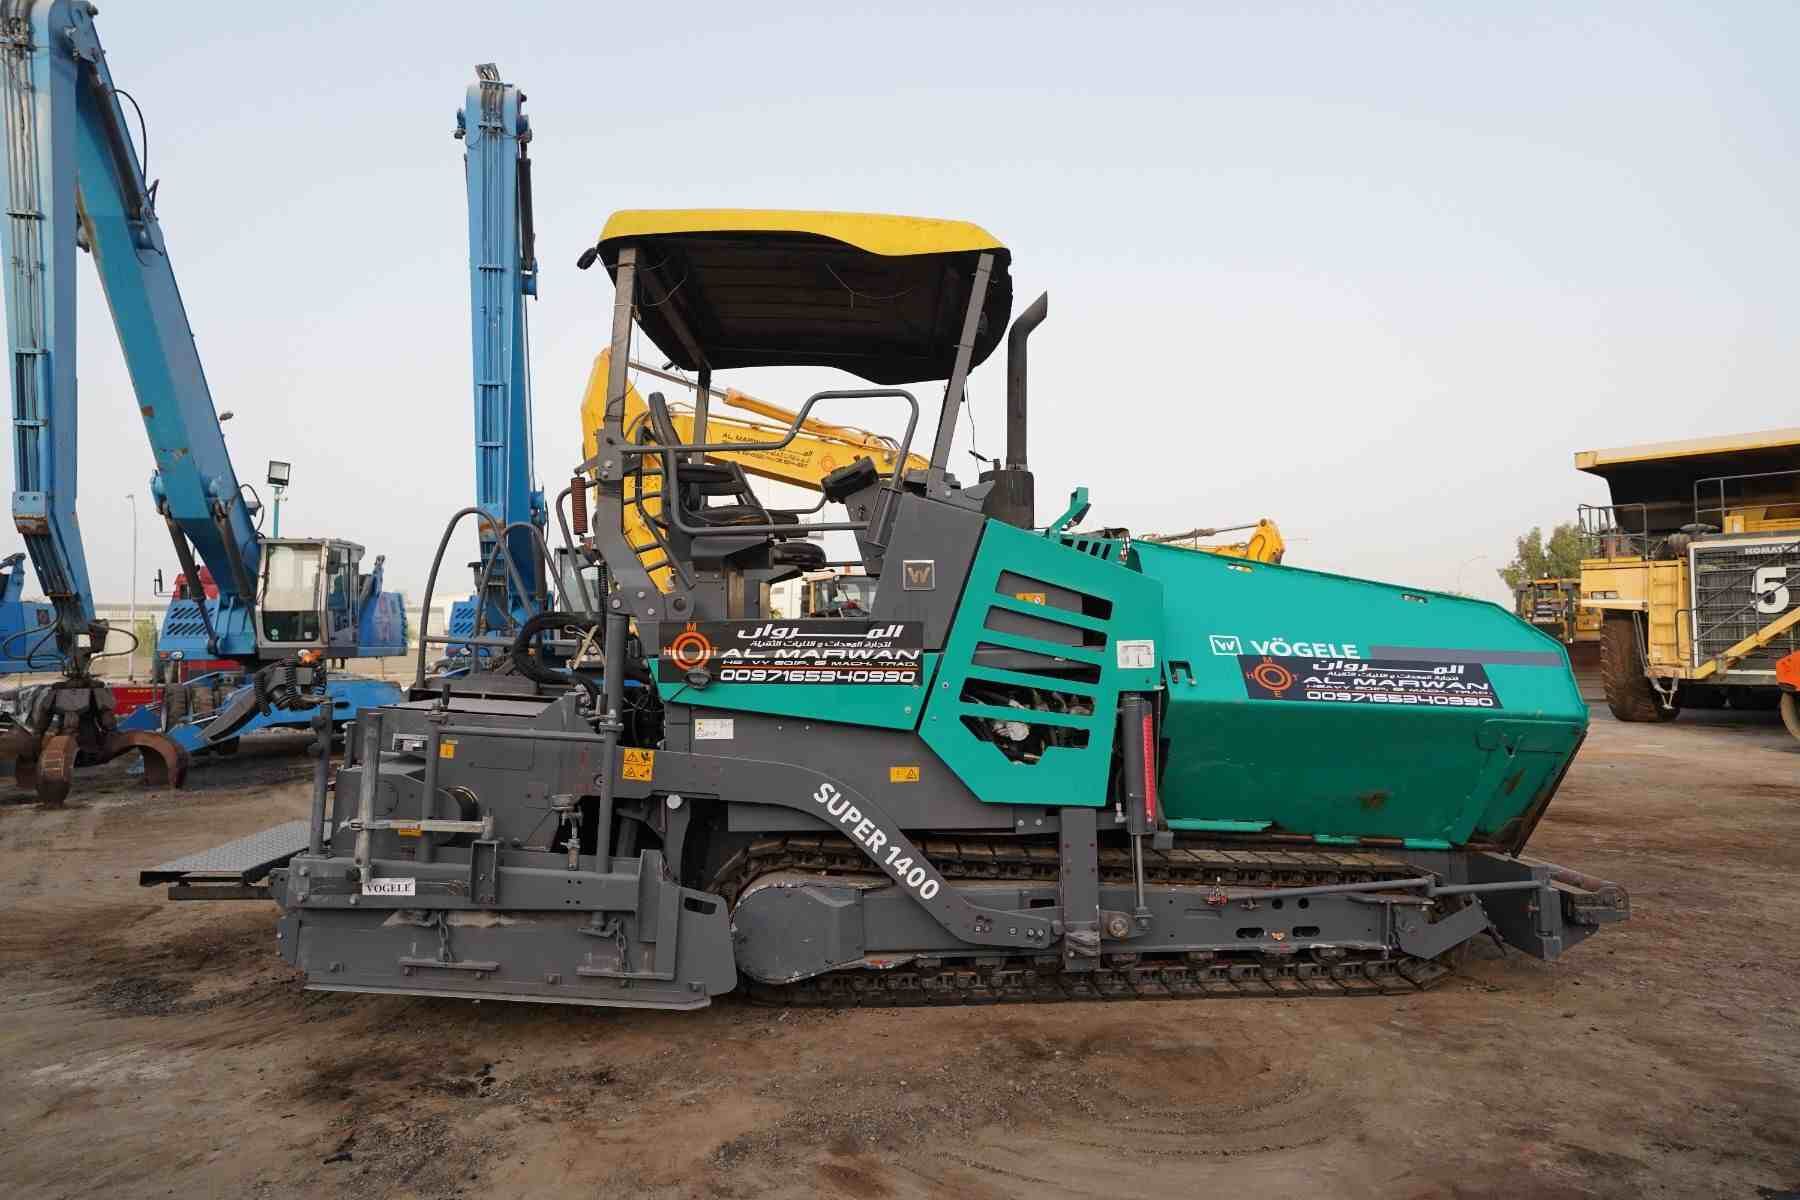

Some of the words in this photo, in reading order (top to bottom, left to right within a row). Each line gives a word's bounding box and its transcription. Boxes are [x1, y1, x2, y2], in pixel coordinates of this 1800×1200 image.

[1751, 567, 1789, 613] 5
[720, 648, 766, 658] AL
[774, 648, 920, 660] MARWAN
[1250, 637, 1361, 659] VÖGELE
[720, 669, 915, 683] 0097165340990
[1303, 676, 1346, 685] AL
[1353, 678, 1488, 690] MARWAN
[1306, 690, 1494, 707] 0097165340990
[813, 783, 887, 854] SUPER
[884, 846, 940, 900] 1400
